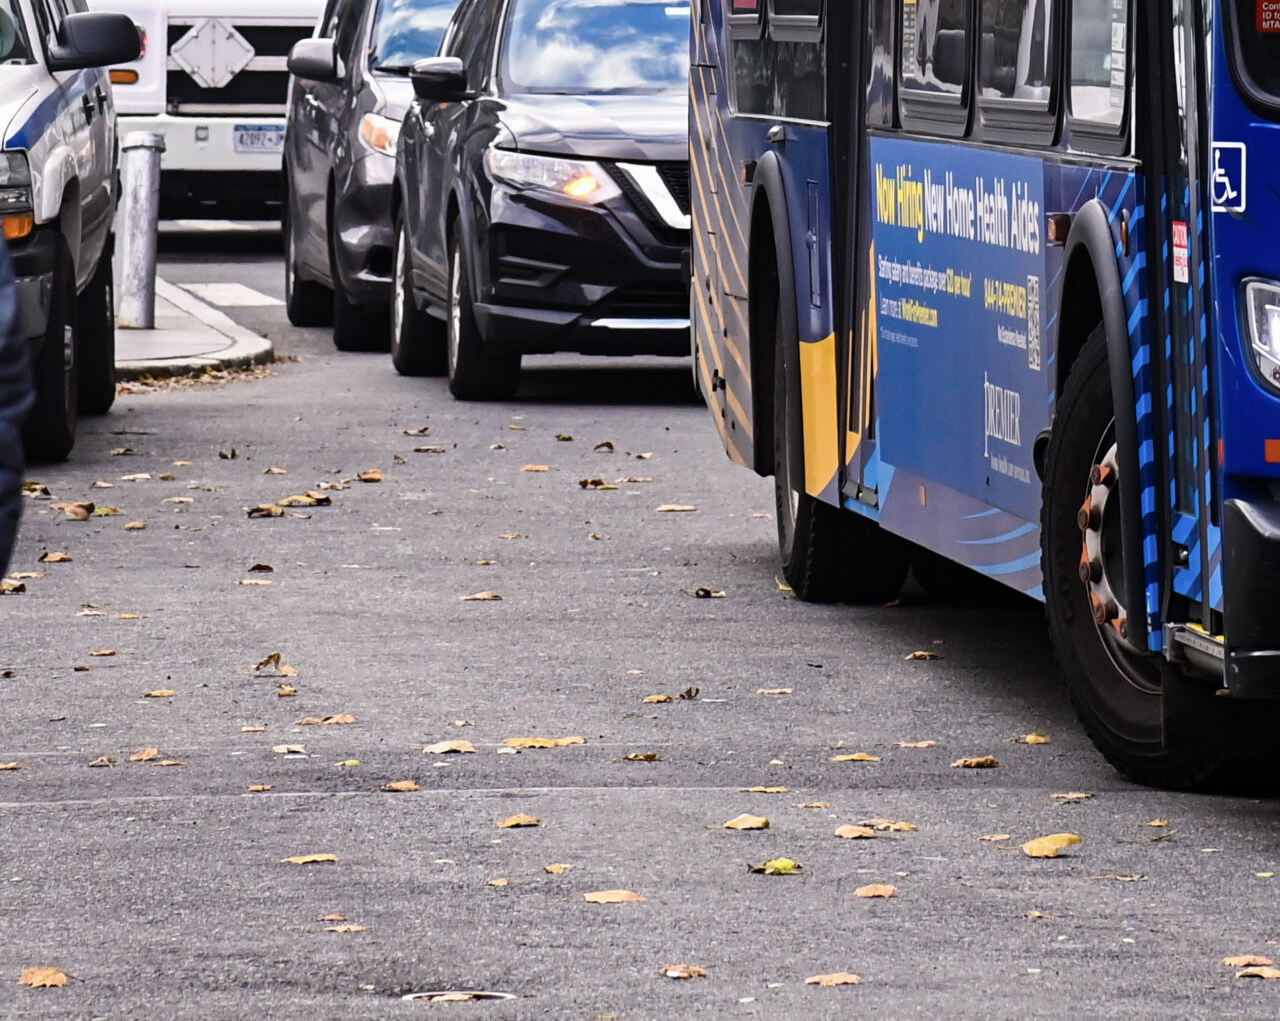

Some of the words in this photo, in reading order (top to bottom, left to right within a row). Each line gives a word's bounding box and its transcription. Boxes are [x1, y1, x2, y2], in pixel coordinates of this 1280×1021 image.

[1262, 11, 1272, 20] ID
[1262, 21, 1280, 29] MTA
[875, 162, 895, 226] Now
[896, 164, 924, 243] Hiring
[924, 168, 944, 234] New
[945, 170, 975, 241] Home
[976, 176, 1009, 248] Health
[1010, 180, 1040, 255] Aides
[984, 370, 1021, 458] PREMIER
